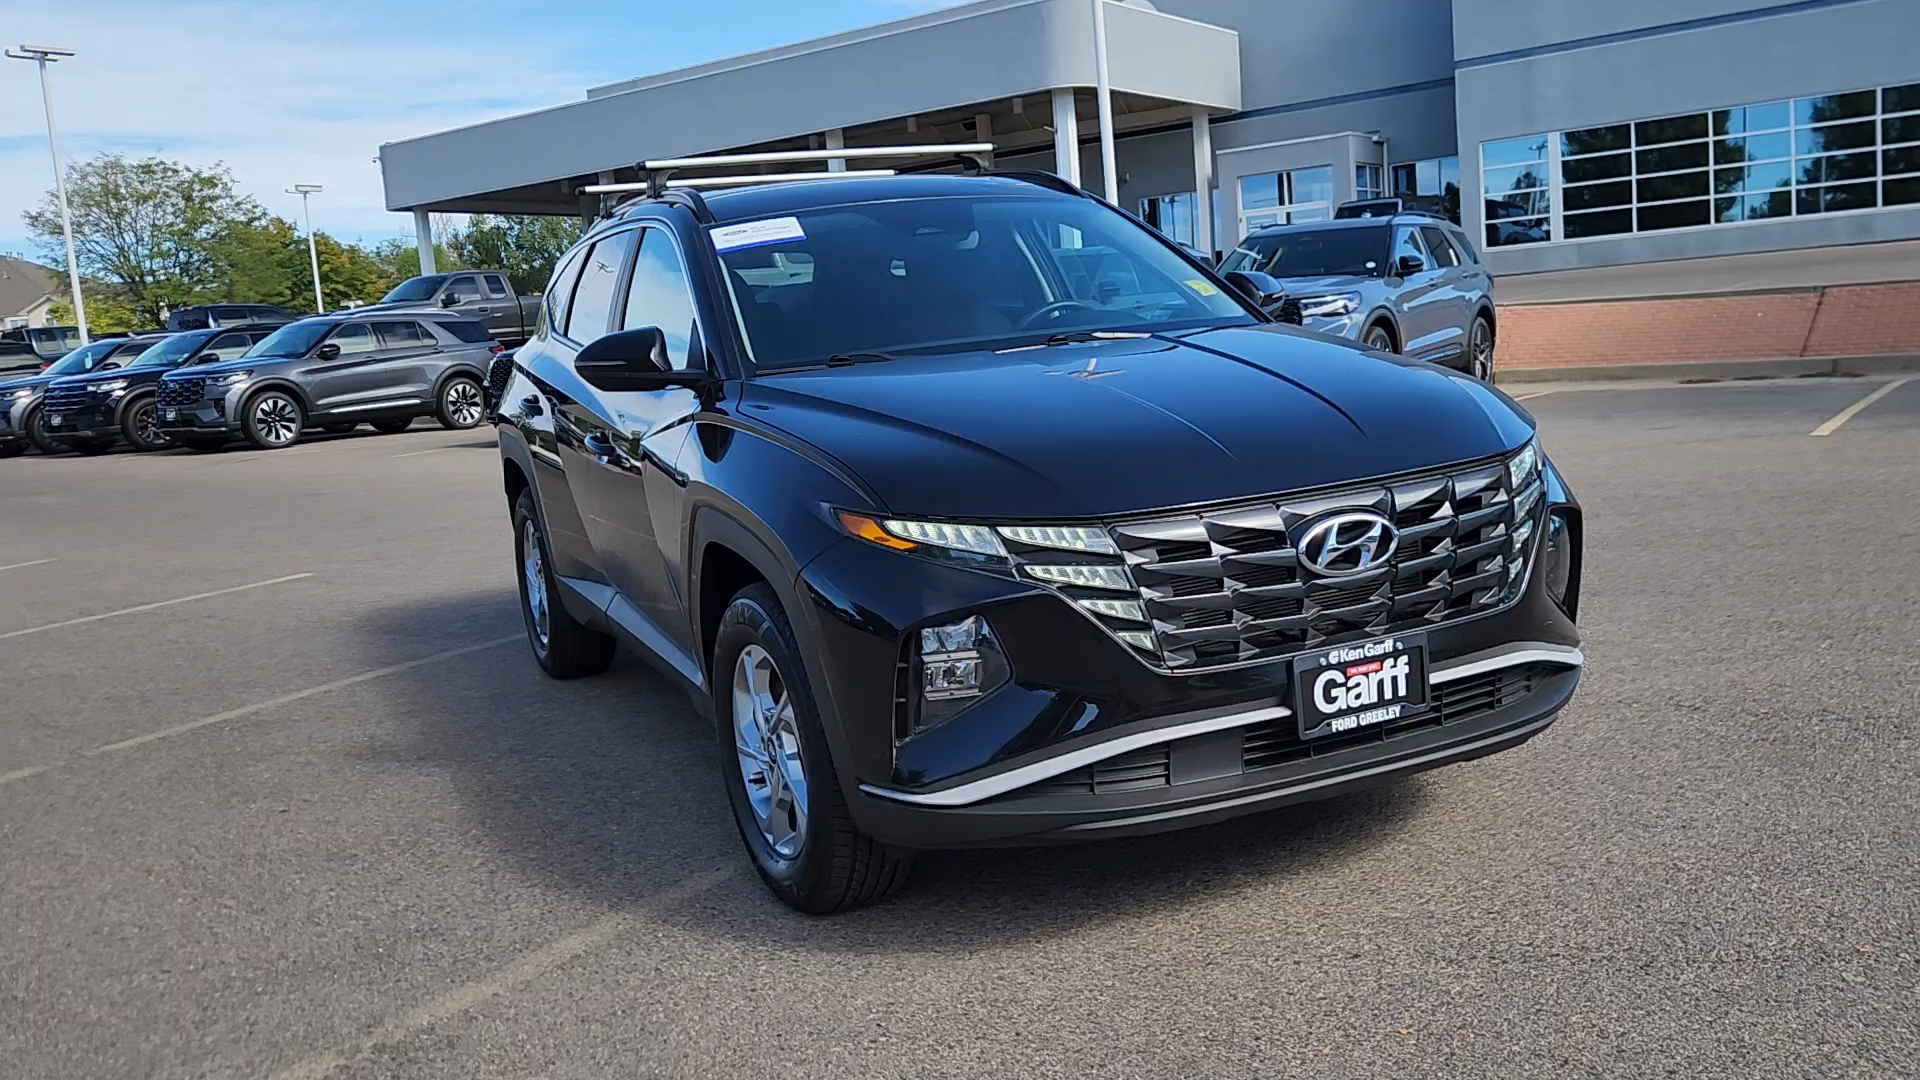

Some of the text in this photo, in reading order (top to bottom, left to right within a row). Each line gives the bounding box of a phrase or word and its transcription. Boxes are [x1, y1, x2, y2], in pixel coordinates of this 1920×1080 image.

[1313, 655, 1410, 714] Garff
[1331, 706, 1401, 732] FORD GREELEY
